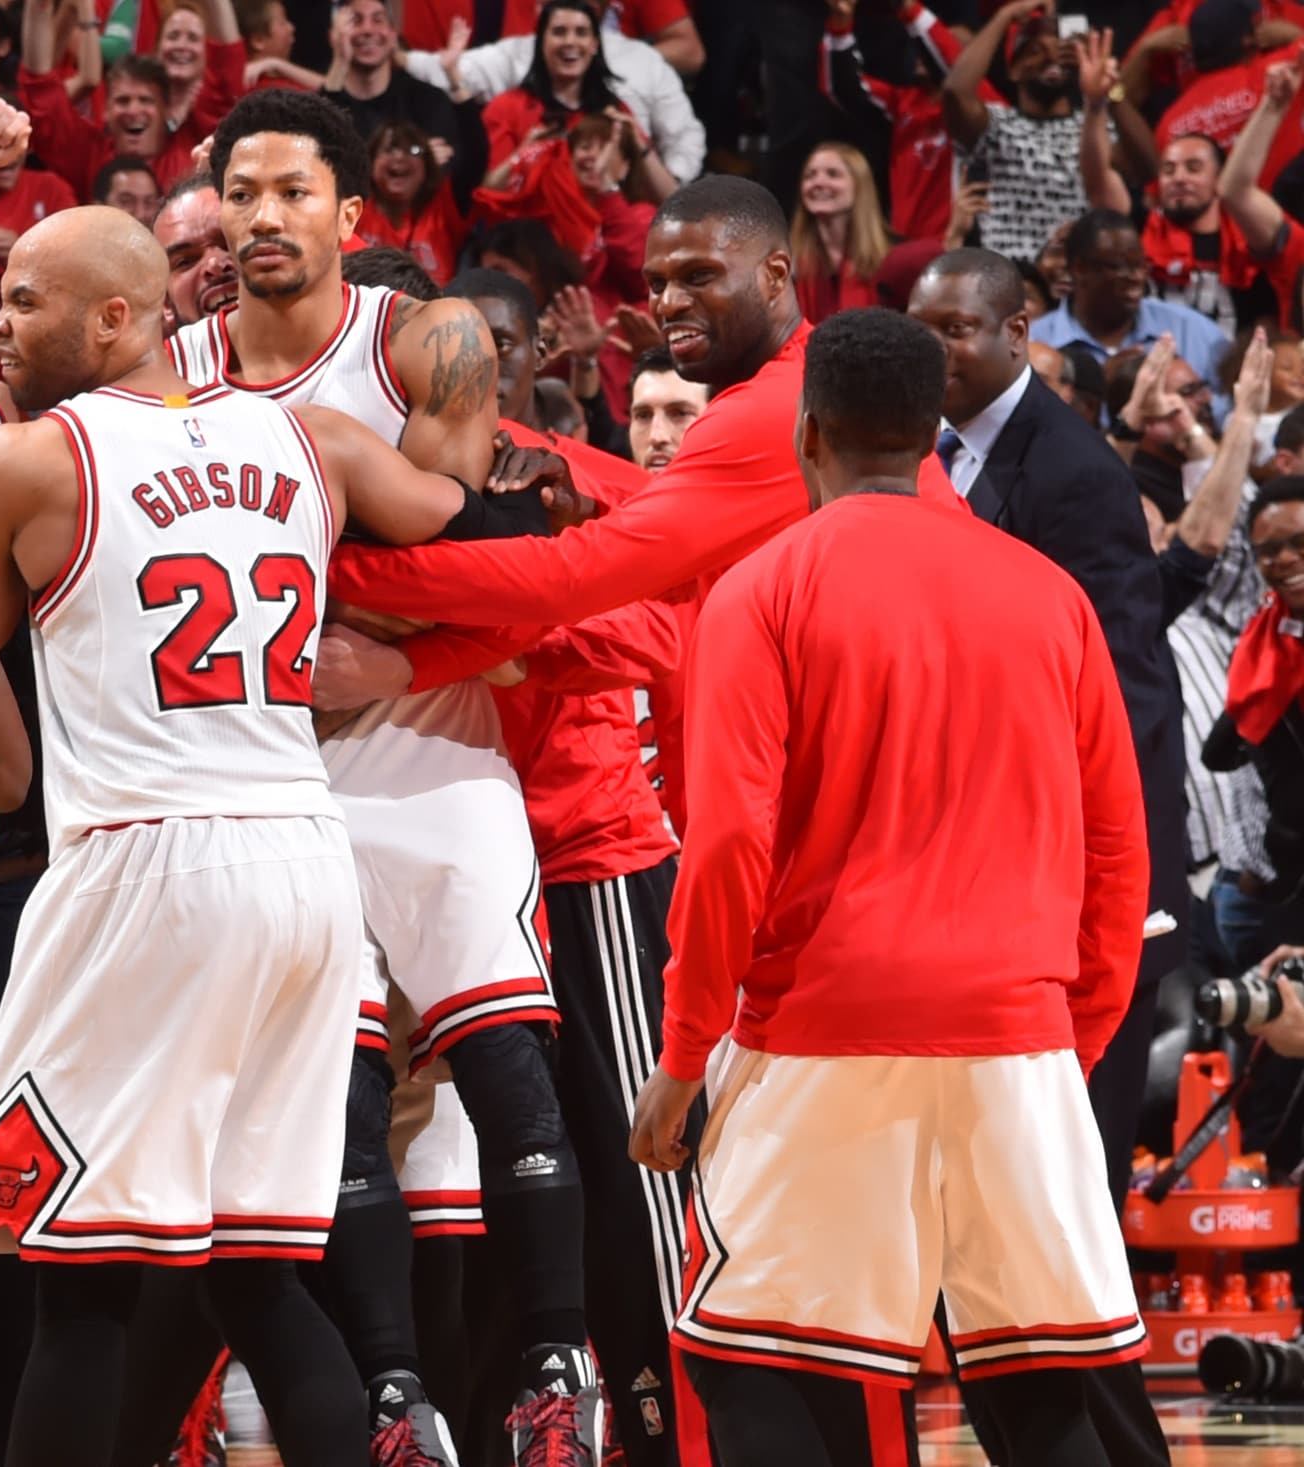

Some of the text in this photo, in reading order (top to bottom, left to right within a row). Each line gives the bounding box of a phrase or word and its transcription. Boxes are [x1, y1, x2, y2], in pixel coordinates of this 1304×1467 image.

[132, 463, 301, 528] GIBSON
[136, 552, 317, 712] 22
[1190, 1206, 1273, 1234] G PRIME
[1174, 1329, 1198, 1356] G
